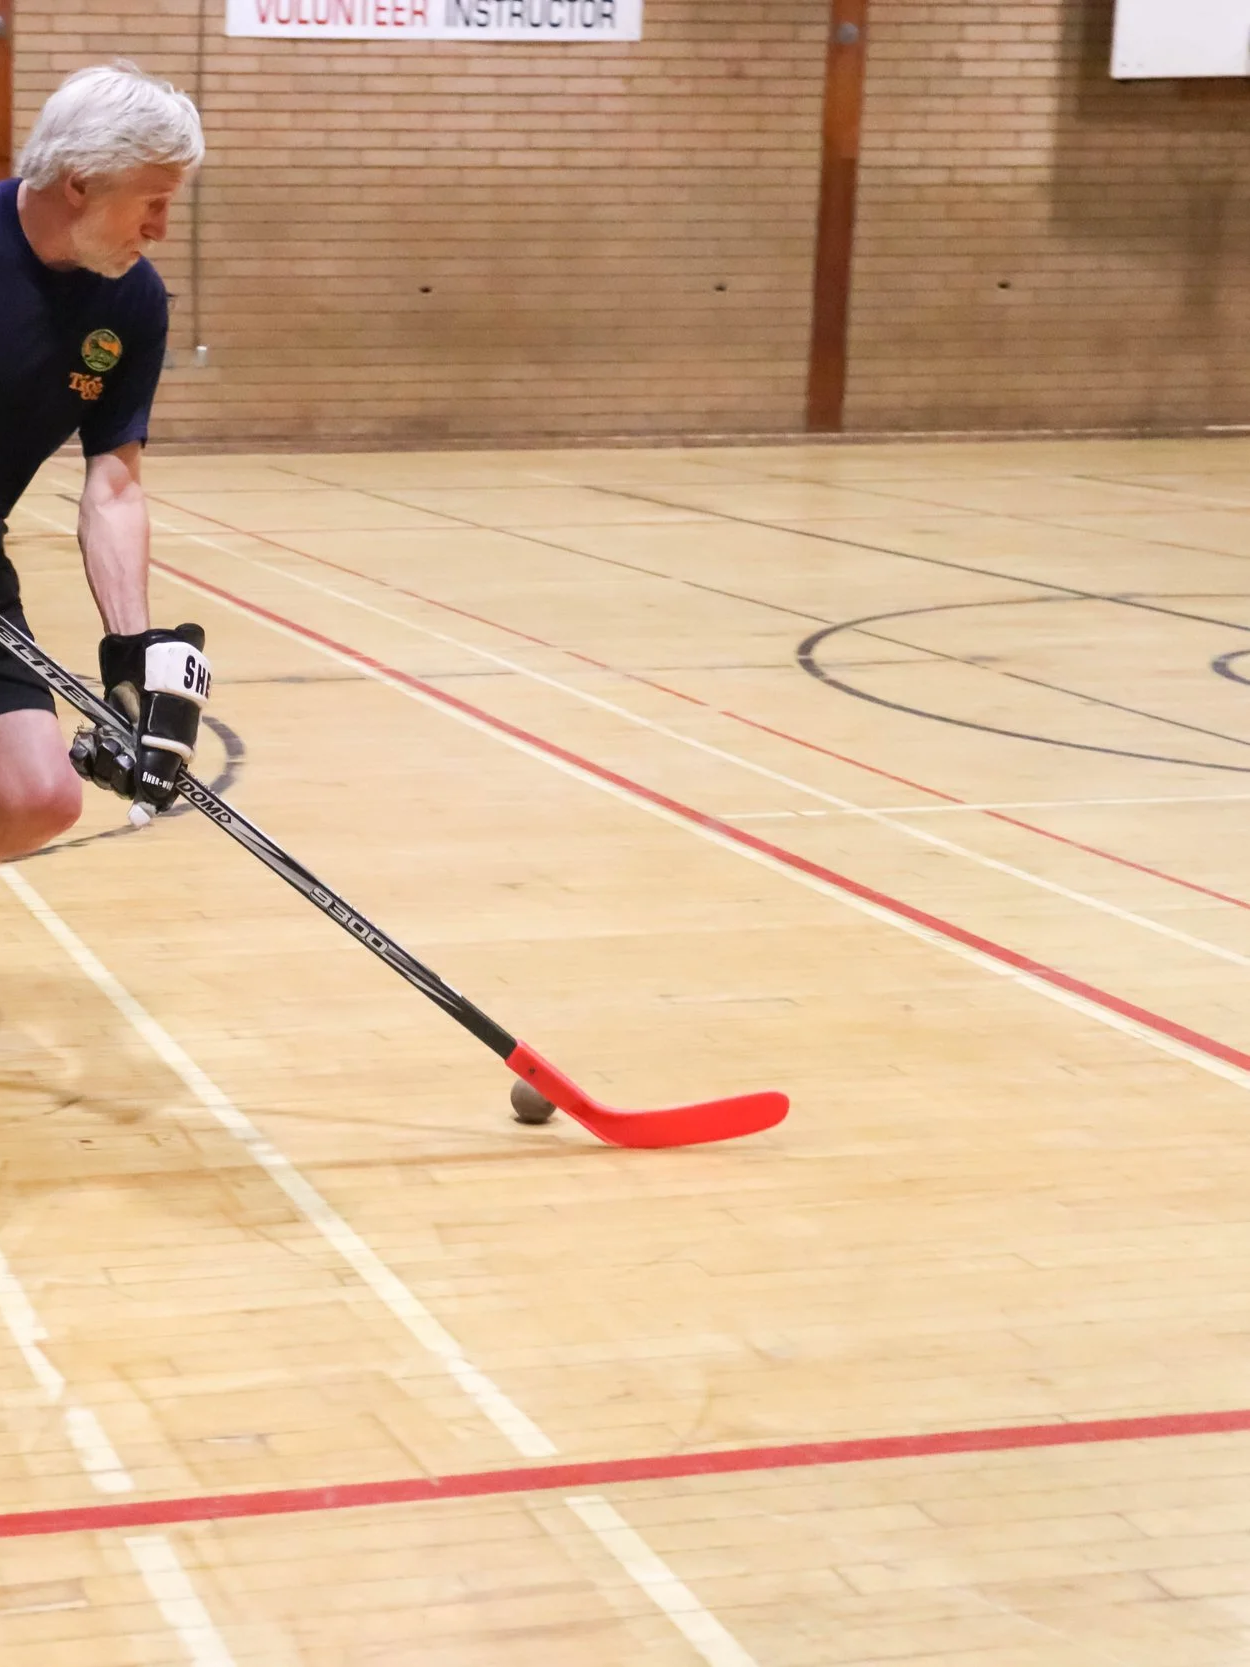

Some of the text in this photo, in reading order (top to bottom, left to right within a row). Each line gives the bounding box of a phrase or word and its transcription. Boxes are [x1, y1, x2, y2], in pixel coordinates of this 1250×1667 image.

[256, 0, 617, 28] VOLUNTEER INSTRUCTOR
[310, 886, 389, 954] 9300
